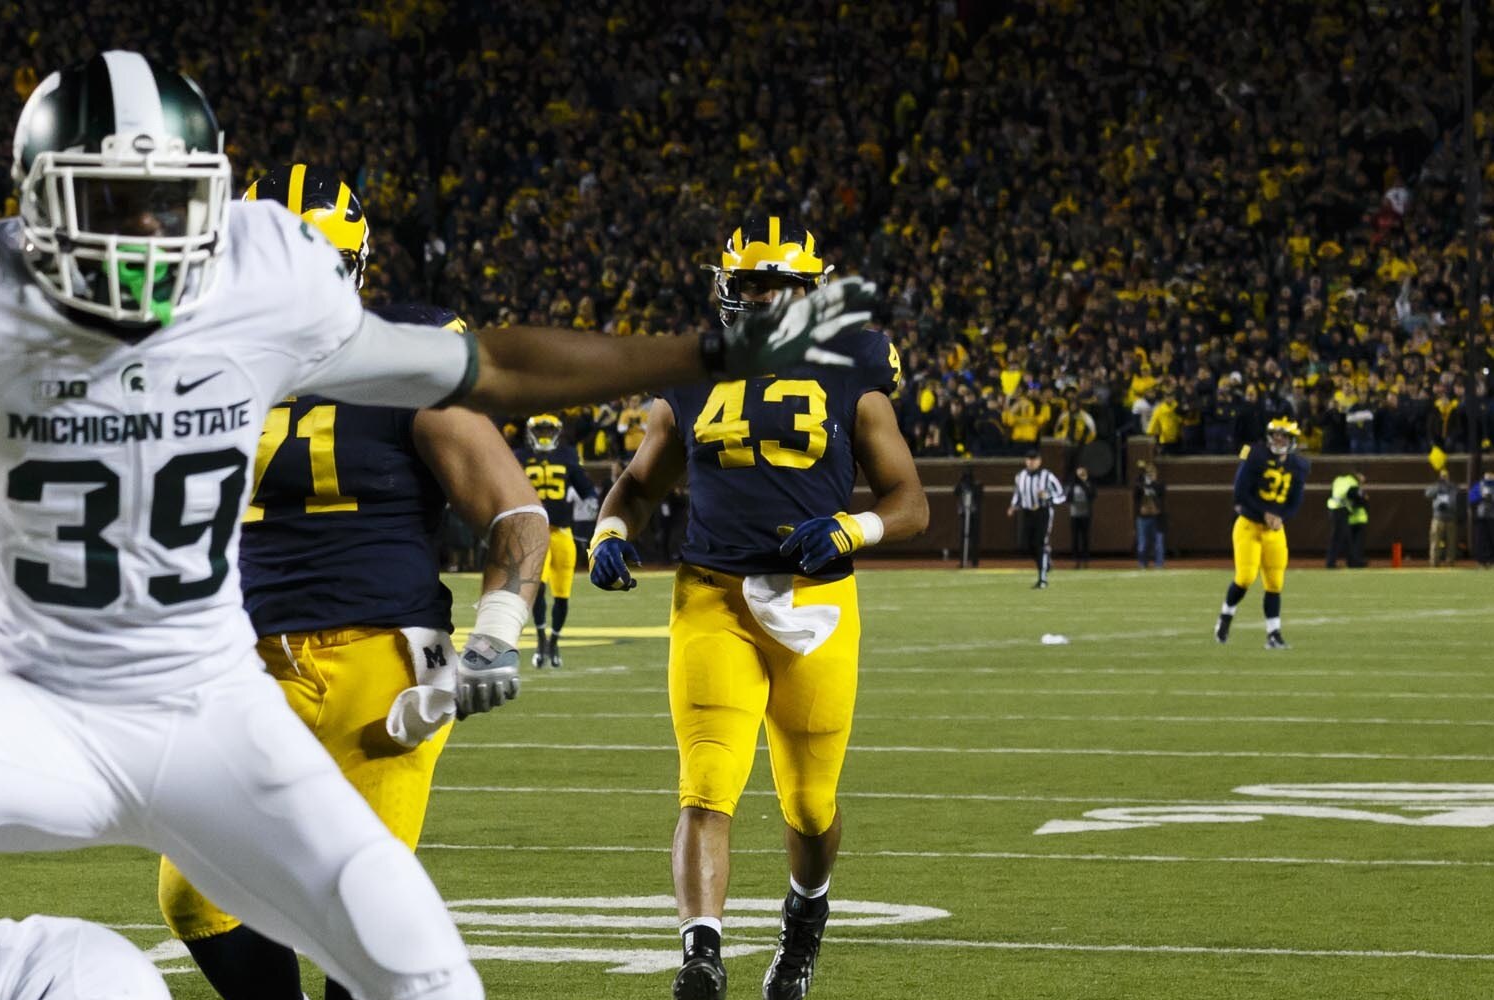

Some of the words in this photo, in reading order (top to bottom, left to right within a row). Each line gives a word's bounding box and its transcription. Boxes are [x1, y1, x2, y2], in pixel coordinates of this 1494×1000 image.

[7, 412, 163, 444] MICHIGAN
[173, 398, 253, 437] STATE
[694, 379, 829, 469] 43
[1259, 468, 1292, 503] 31
[6, 446, 249, 610] 39
